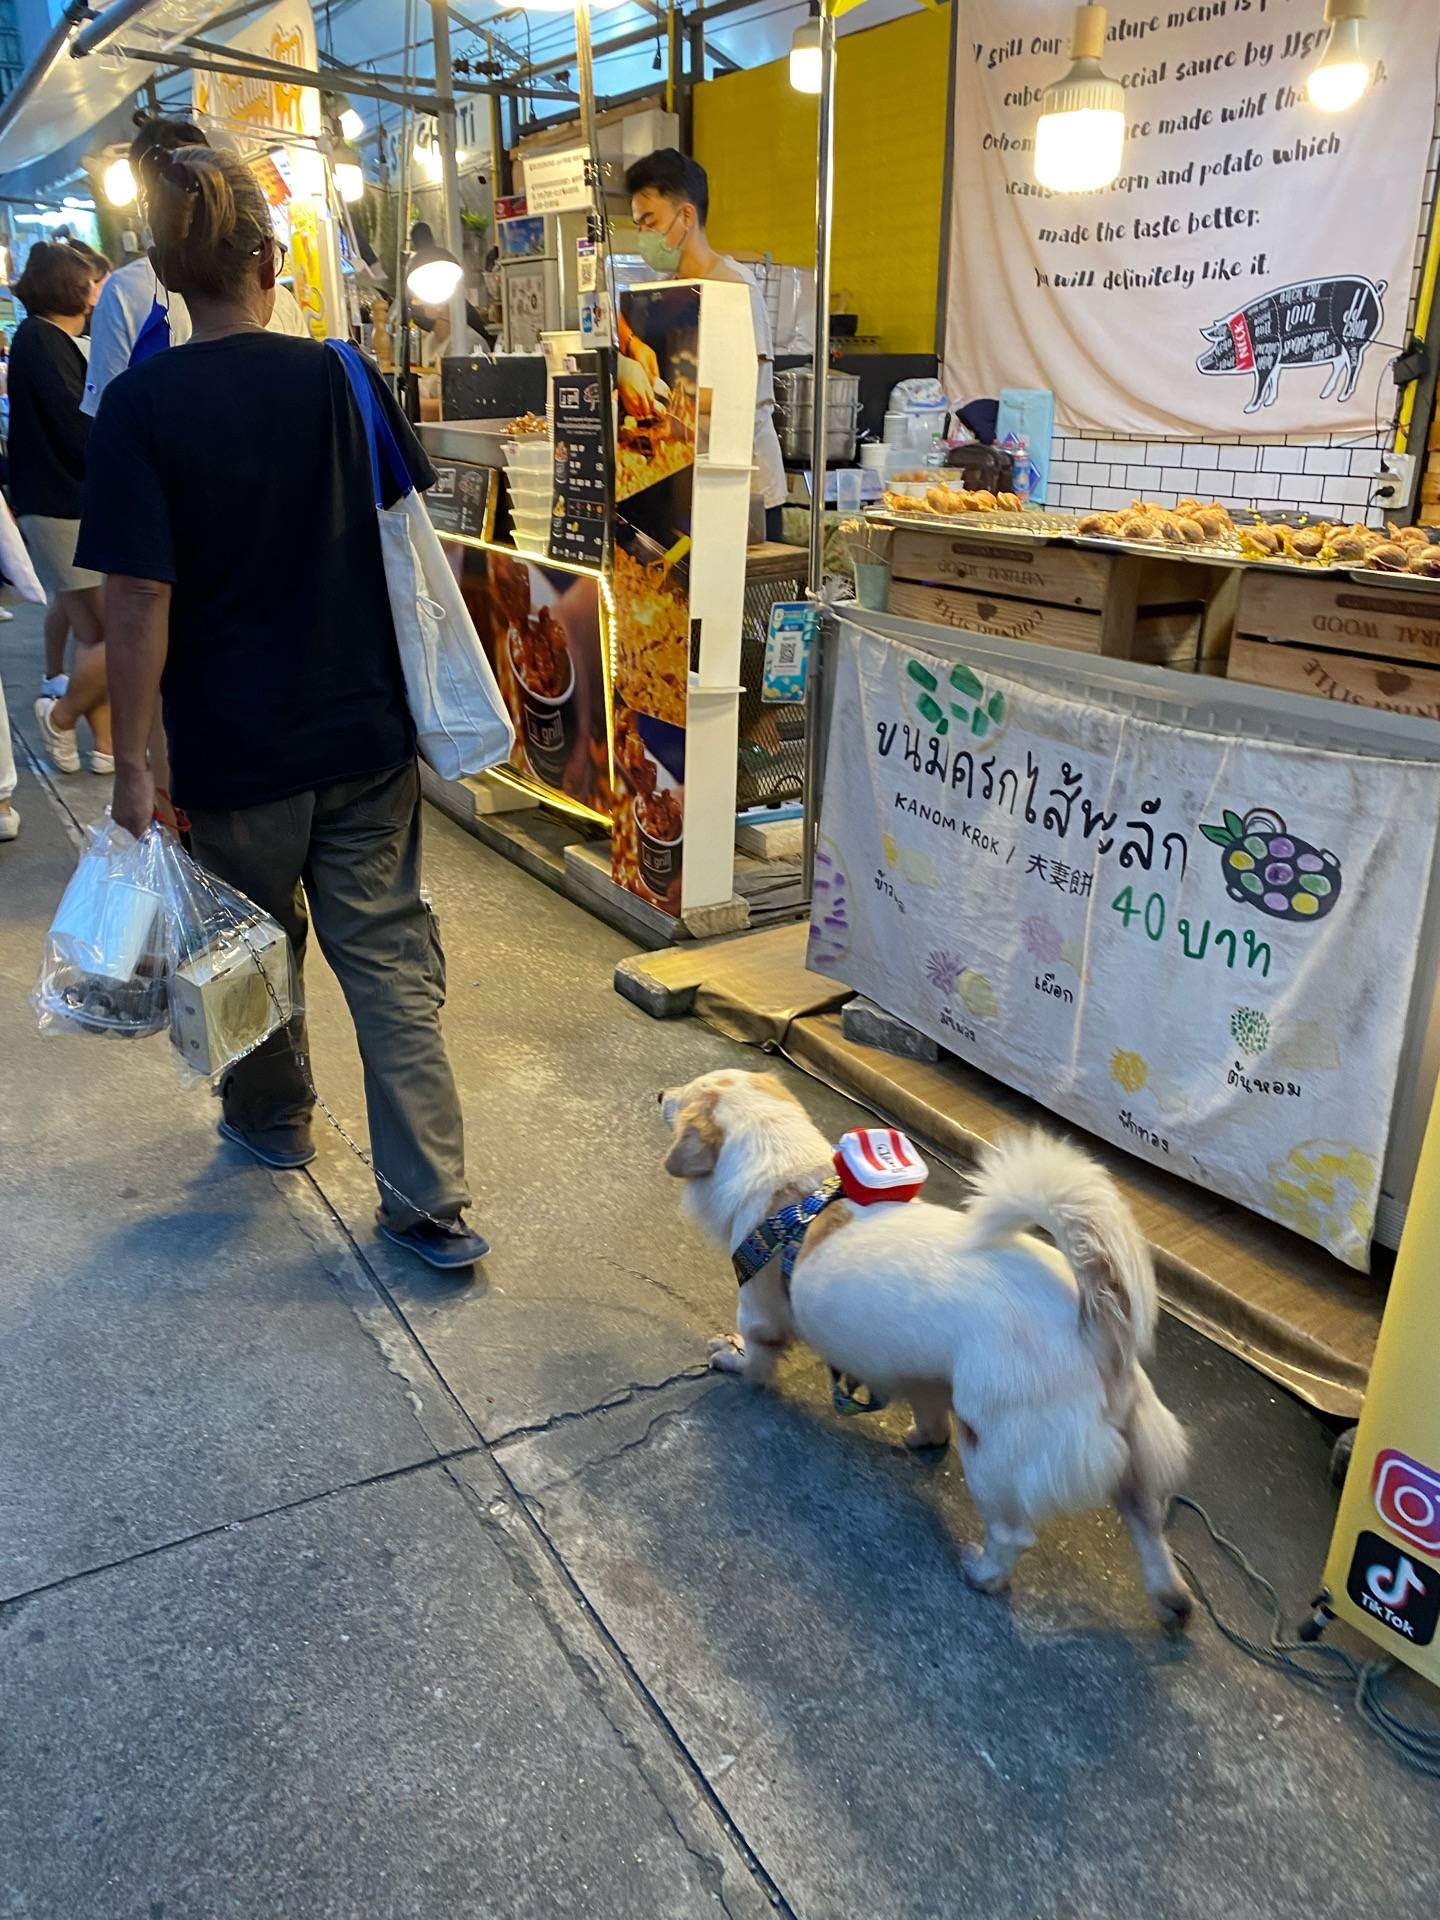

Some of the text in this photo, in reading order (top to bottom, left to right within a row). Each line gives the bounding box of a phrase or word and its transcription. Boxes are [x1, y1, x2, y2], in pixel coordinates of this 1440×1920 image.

[987, 38, 1022, 69] grill
[1031, 36, 1063, 55] Our
[1167, 1, 1226, 28] menu
[1120, 62, 1167, 89] ecial
[1176, 50, 1236, 81] sauce
[1244, 42, 1273, 66] by
[1159, 108, 1213, 134] made
[1221, 93, 1267, 123] wiht
[1111, 174, 1149, 193] corn
[1156, 162, 1193, 185] and
[1200, 148, 1263, 186] potato
[1273, 132, 1341, 165] which
[1038, 224, 1090, 245] made
[1096, 221, 1126, 242] the
[1133, 215, 1181, 240] taste
[1054, 270, 1095, 287] will
[1103, 264, 1195, 290] definitely
[1202, 258, 1242, 281] like
[1250, 253, 1270, 275] it.
[1312, 614, 1379, 638] WOOD
[895, 792, 956, 831] KANOM
[962, 821, 1000, 855] KROK
[1112, 885, 1271, 977] 40 บาท
[1227, 1060, 1301, 1097] ต้นหอม
